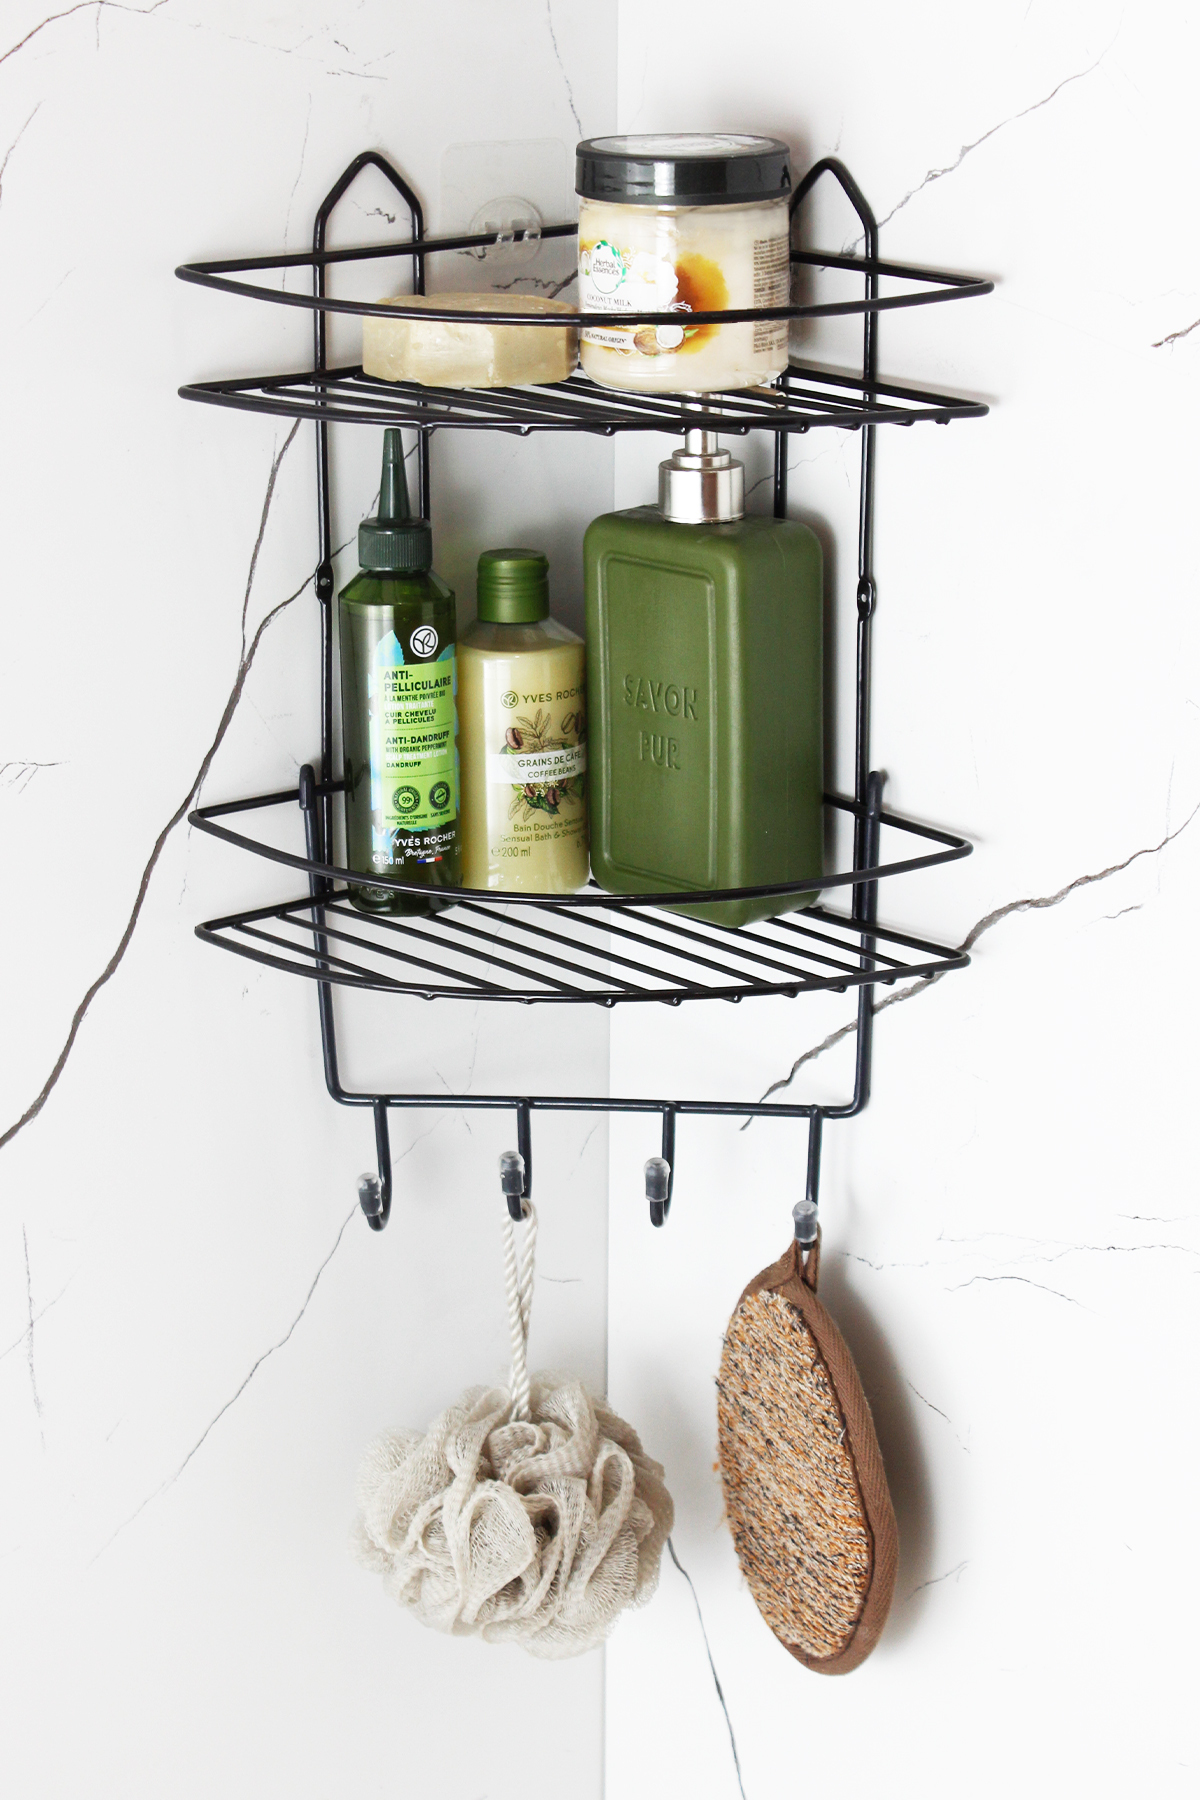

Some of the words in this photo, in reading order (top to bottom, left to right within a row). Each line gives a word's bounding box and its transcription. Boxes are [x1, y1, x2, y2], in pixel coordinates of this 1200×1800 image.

[595, 258, 616, 269] Herbal
[593, 264, 620, 276] Essences
[587, 293, 611, 304] COCONUT
[613, 298, 632, 307] MILK
[384, 670, 413, 680] ANTI-
[384, 675, 451, 692] PELLICULAIRE
[396, 693, 419, 702] MENTHE
[522, 693, 553, 704] YVES
[623, 674, 698, 720] SAVON
[384, 701, 405, 711] LOTION
[405, 700, 434, 710] TRAITANTE
[404, 708, 437, 718] CHEVELU
[393, 715, 435, 725] PELLICULES
[386, 730, 450, 744] ANTI-DANDRUFF
[400, 745, 421, 753] ORGANIC
[421, 741, 448, 751] PEPPERMINT
[639, 731, 681, 770] PUR
[518, 758, 553, 768] GRAINS
[554, 755, 564, 765] DE
[527, 768, 558, 778] COFFEE
[558, 764, 577, 775] BEANS
[513, 824, 532, 832] Bain
[533, 821, 564, 831] Douche
[395, 838, 421, 847] YVES
[424, 831, 456, 845] ROCHER
[500, 834, 533, 843] Sensual
[534, 832, 552, 842] Bath
[553, 831, 561, 839] &
[501, 846, 519, 857] 200
[520, 846, 531, 857] ml
[382, 855, 394, 865] 150
[395, 856, 404, 865] ml
